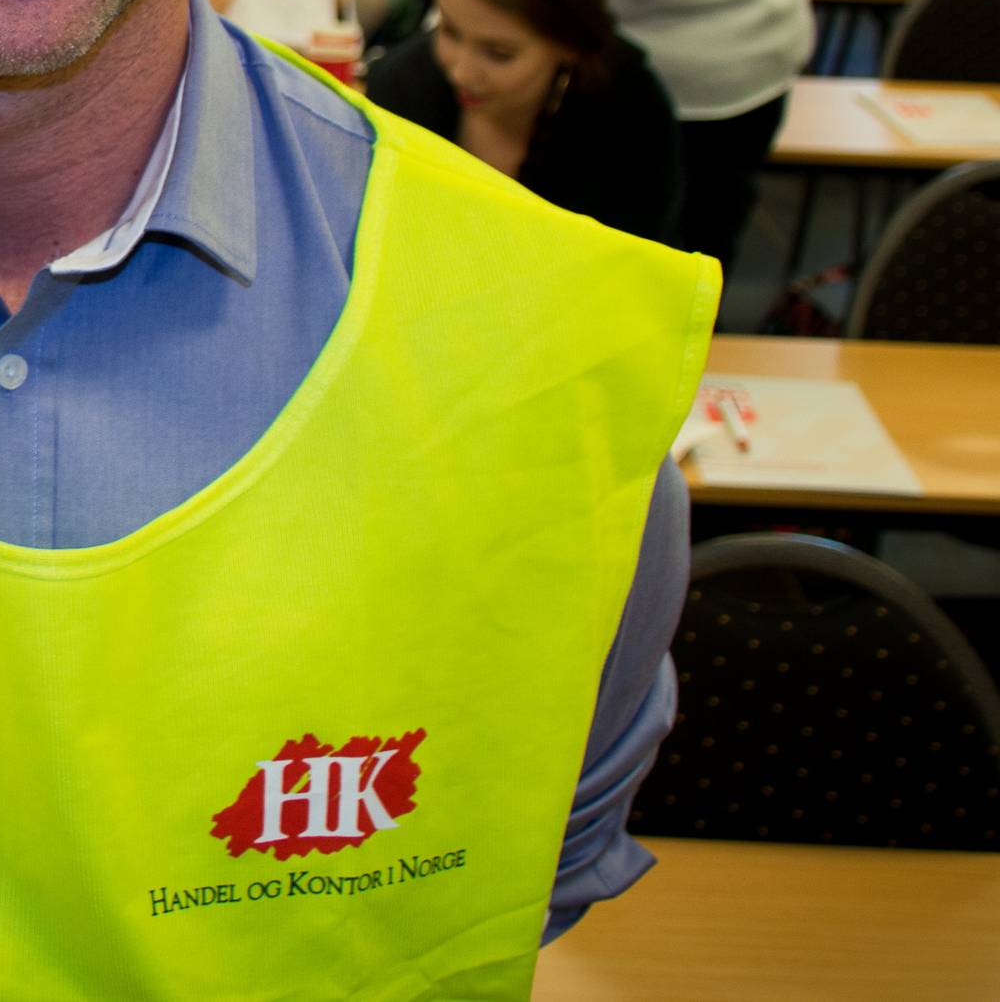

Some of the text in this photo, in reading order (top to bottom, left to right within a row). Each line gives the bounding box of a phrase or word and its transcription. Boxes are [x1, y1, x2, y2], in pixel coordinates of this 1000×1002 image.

[254, 749, 400, 843] HK
[149, 848, 467, 916] HANDEL OG KONTOR I NORGE
